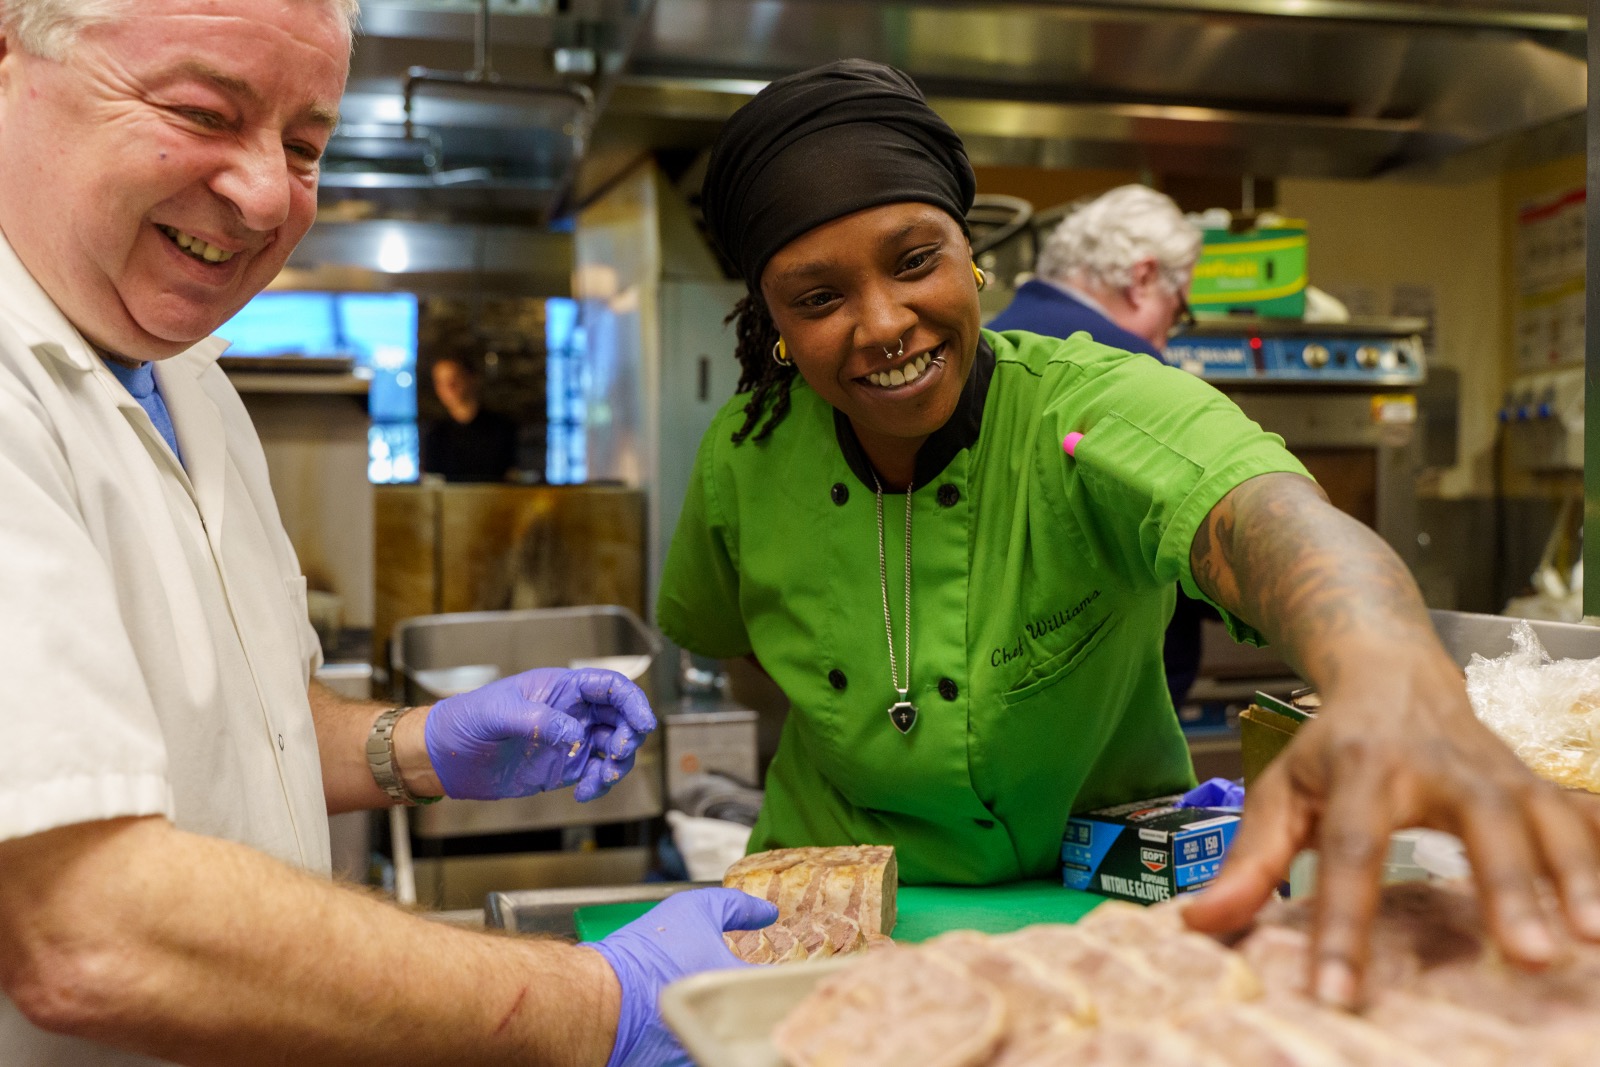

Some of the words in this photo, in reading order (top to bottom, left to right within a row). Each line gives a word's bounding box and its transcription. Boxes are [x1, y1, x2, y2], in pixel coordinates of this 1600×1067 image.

[990, 636, 1024, 668] Chef
[1025, 589, 1102, 640] Williams
[1204, 835, 1219, 850] 150
[1142, 850, 1165, 863] EQPT
[1100, 873, 1136, 897] NITRILE
[1134, 881, 1171, 904] GLOVES
